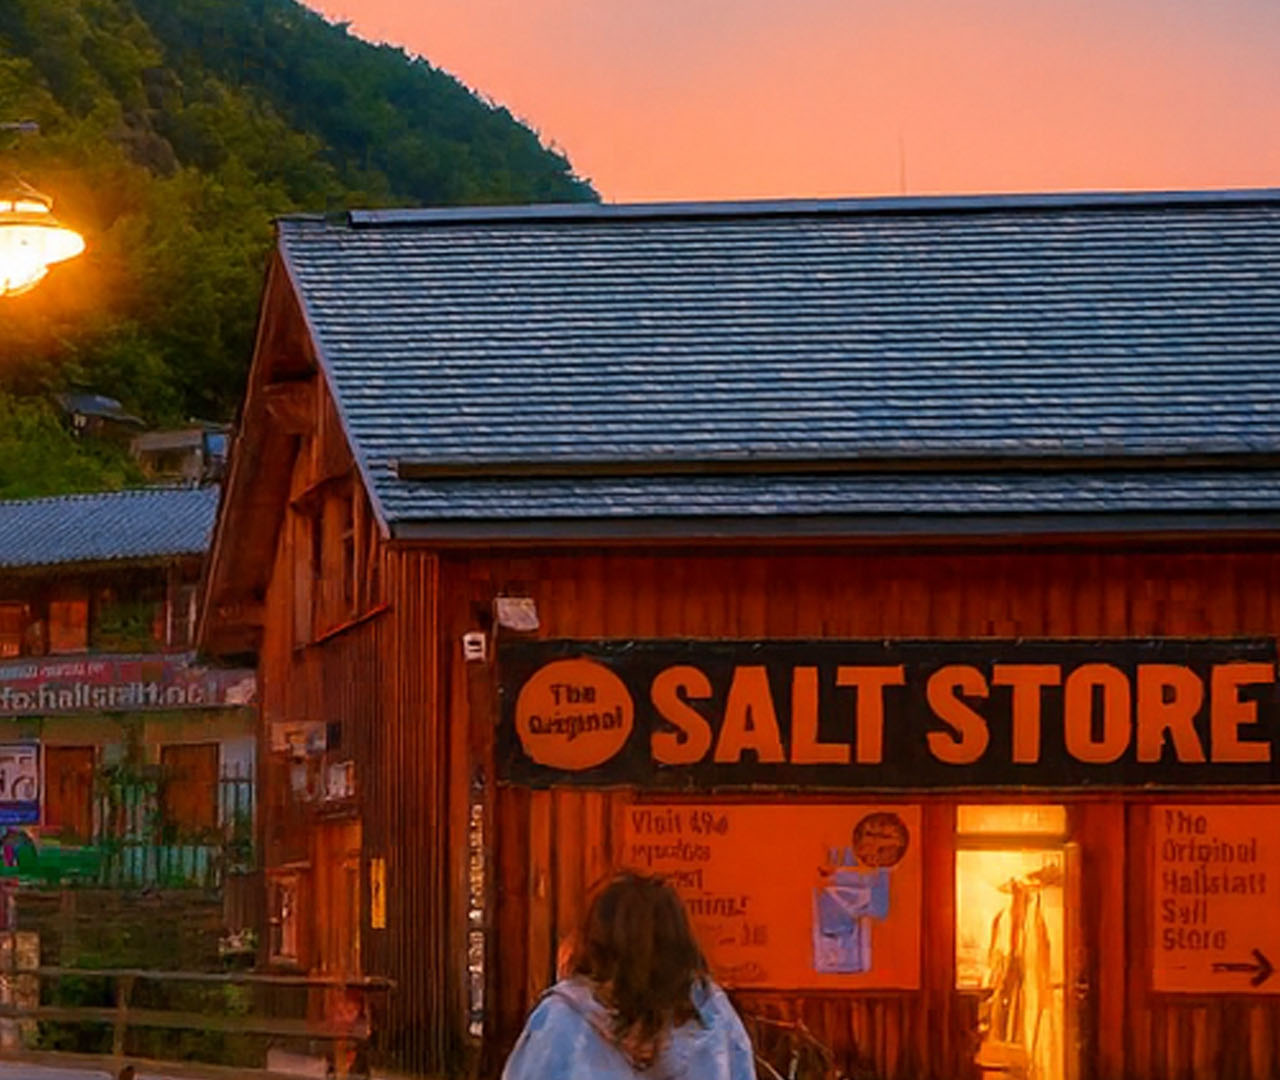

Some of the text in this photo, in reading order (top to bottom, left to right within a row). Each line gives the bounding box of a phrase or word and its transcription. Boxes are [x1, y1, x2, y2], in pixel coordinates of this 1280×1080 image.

[548, 683, 596, 706] The
[529, 704, 623, 742] Original
[650, 663, 1276, 765] SALT STORE
